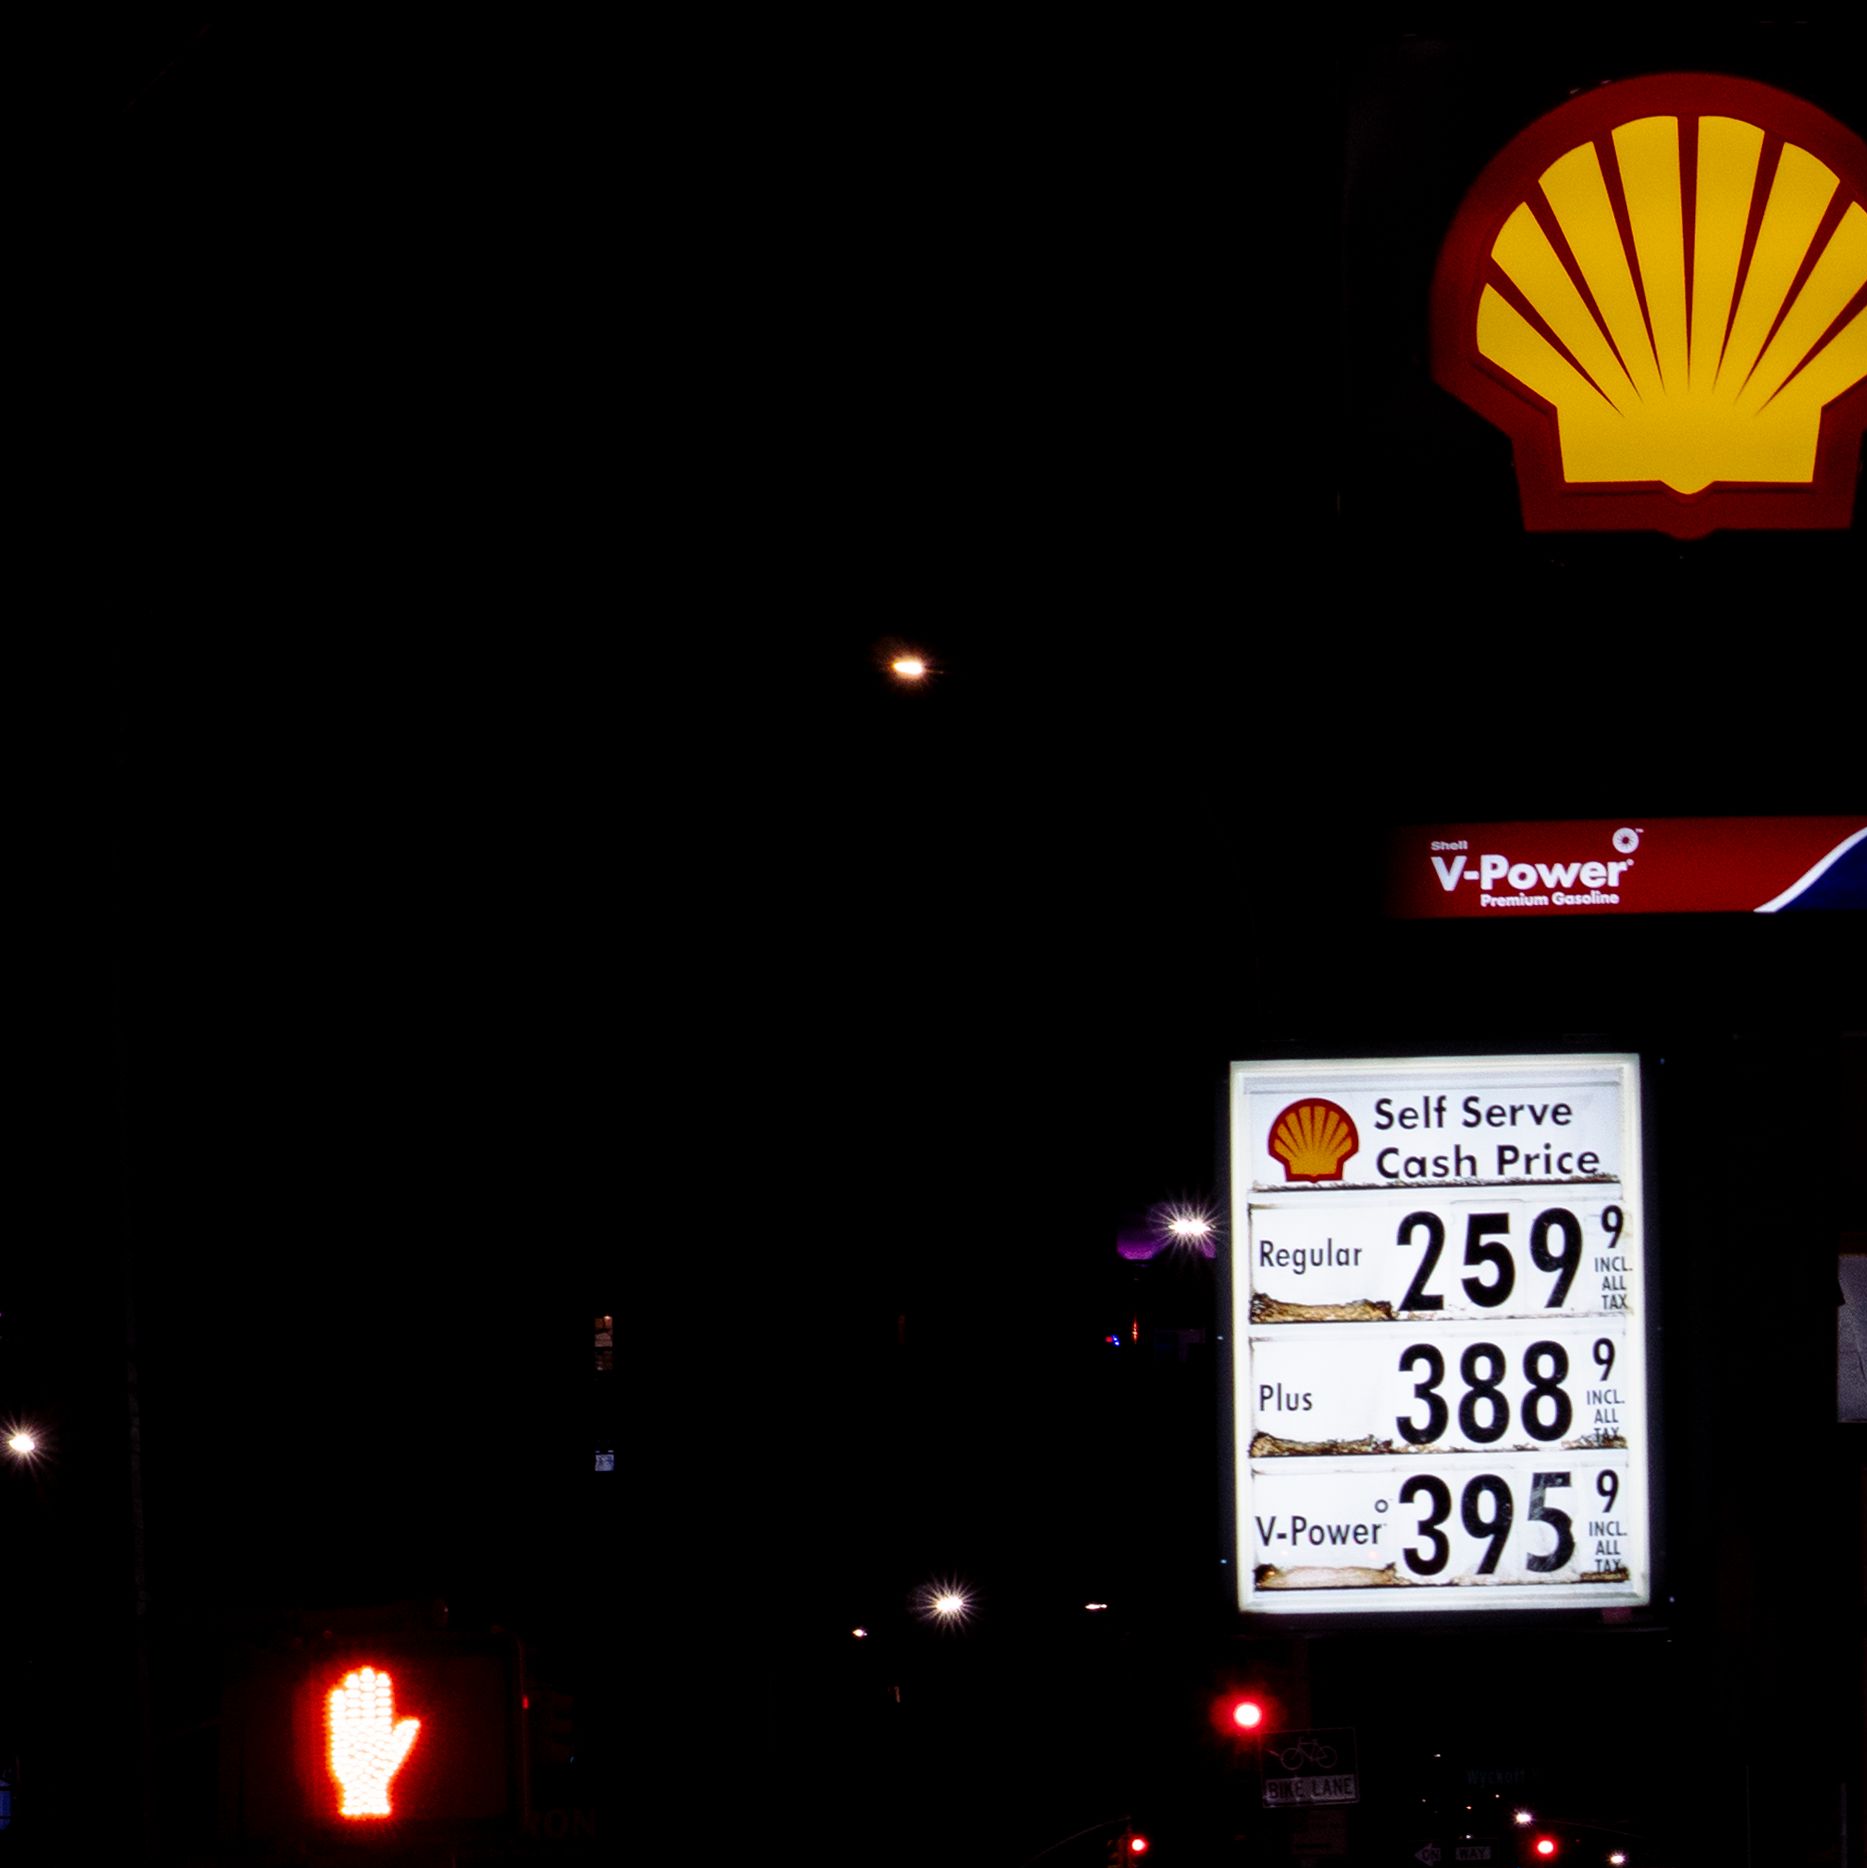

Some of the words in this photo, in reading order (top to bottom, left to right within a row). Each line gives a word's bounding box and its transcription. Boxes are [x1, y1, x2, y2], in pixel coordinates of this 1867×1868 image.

[1431, 840, 1468, 851] Shell
[1431, 854, 1629, 891] V-Power
[1480, 893, 1549, 907] Premium
[1551, 890, 1620, 905] Gasoline
[1373, 1095, 1447, 1130] Self
[1462, 1096, 1573, 1128] Serve
[1376, 1144, 1478, 1179] Cash
[1497, 1143, 1601, 1176] Price
[1259, 1238, 1363, 1274] Regular
[1396, 1207, 1583, 1312] 259
[1601, 1205, 1624, 1249] 9
[1594, 1257, 1632, 1272] INCL.
[1602, 1277, 1627, 1291] ALL
[1601, 1294, 1628, 1310] TAX
[1259, 1382, 1313, 1412] Plus
[1396, 1340, 1573, 1445] 388
[1592, 1338, 1615, 1382] 9
[1587, 1390, 1625, 1405] INCL.
[1594, 1409, 1618, 1423] ALL
[1256, 1515, 1383, 1546] V-Power
[1399, 1471, 1576, 1576] 395
[1597, 1469, 1619, 1513] 9
[1589, 1521, 1628, 1537] INCL.
[1595, 1540, 1621, 1555] ALL
[1268, 1780, 1304, 1799] BIKE
[1311, 1777, 1352, 1797] LANE
